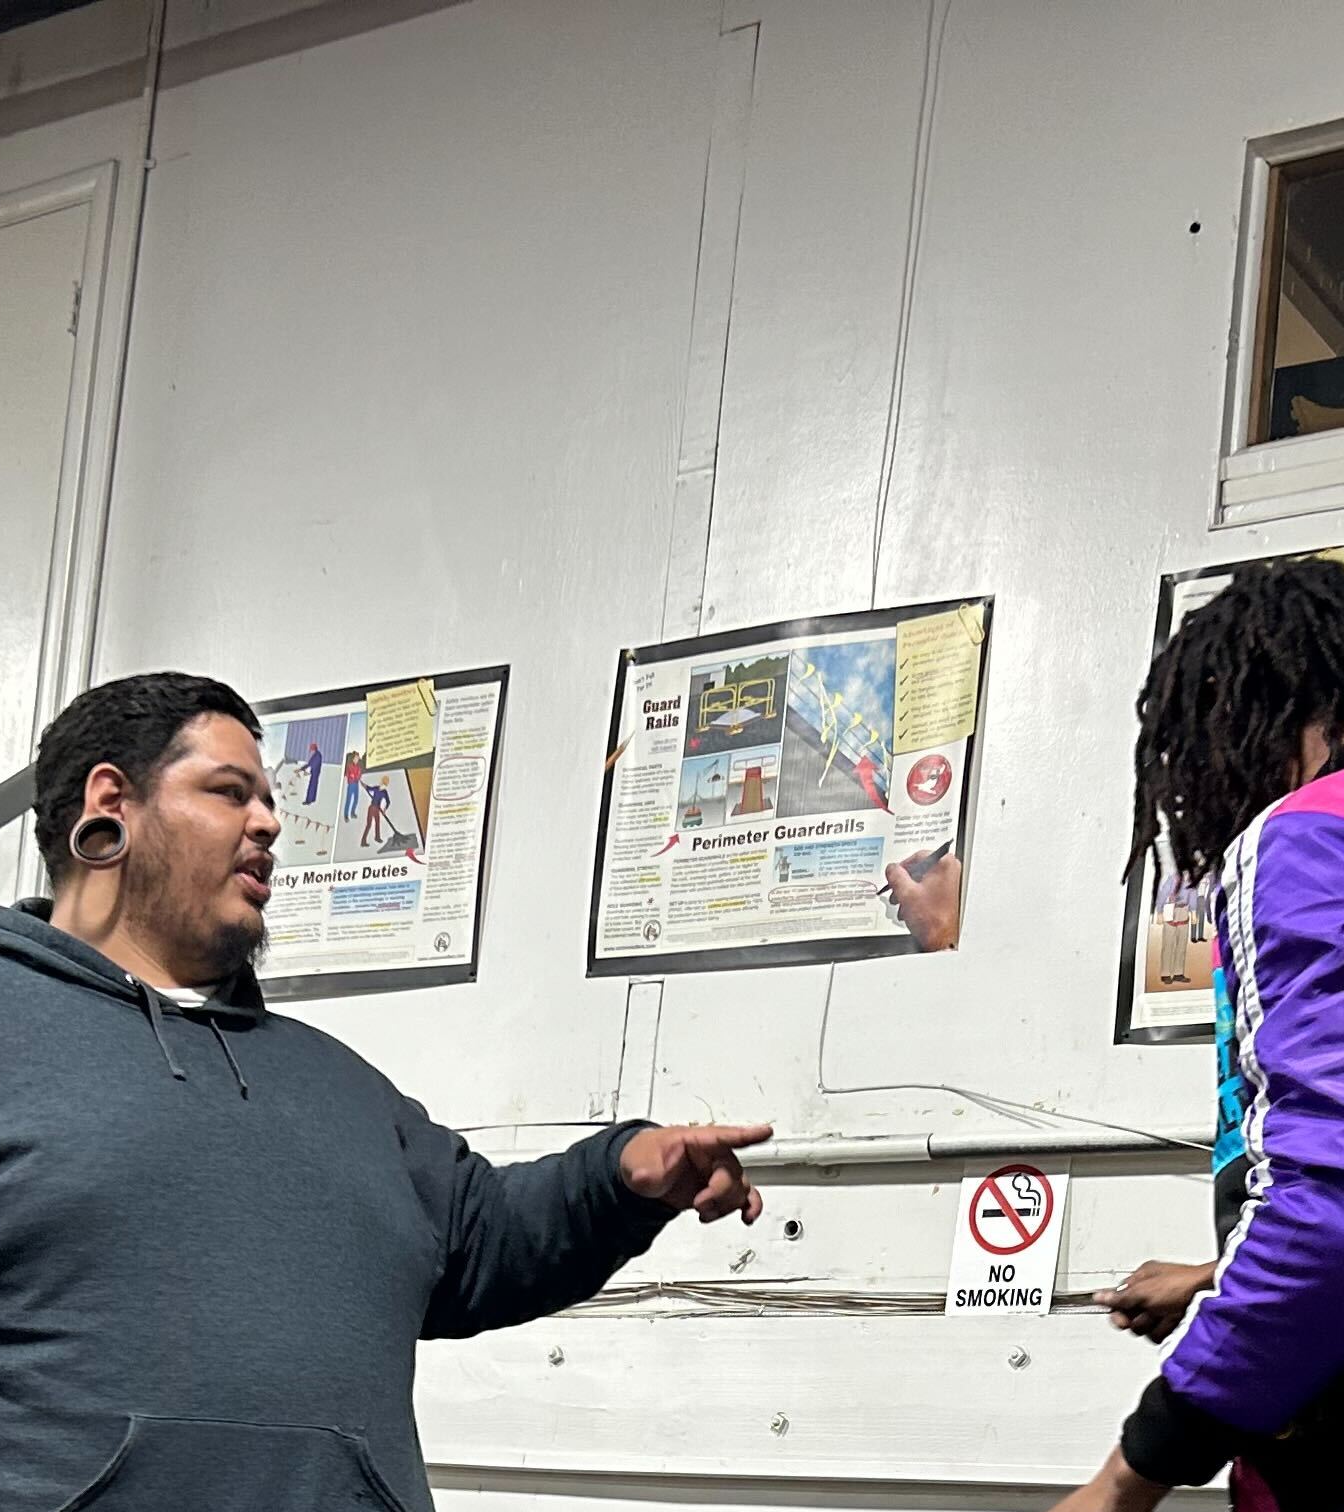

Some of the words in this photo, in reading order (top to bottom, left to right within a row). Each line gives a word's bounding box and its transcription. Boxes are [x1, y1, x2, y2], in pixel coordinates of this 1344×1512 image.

[643, 696, 682, 714] Guard
[645, 714, 680, 731] Rails
[692, 830, 770, 851] Perimeter
[774, 818, 865, 840] Guardrails
[302, 867, 360, 885] Monitor
[362, 865, 408, 879] Duties
[988, 1264, 1015, 1283] NO
[956, 1287, 1043, 1307] SMOKING
